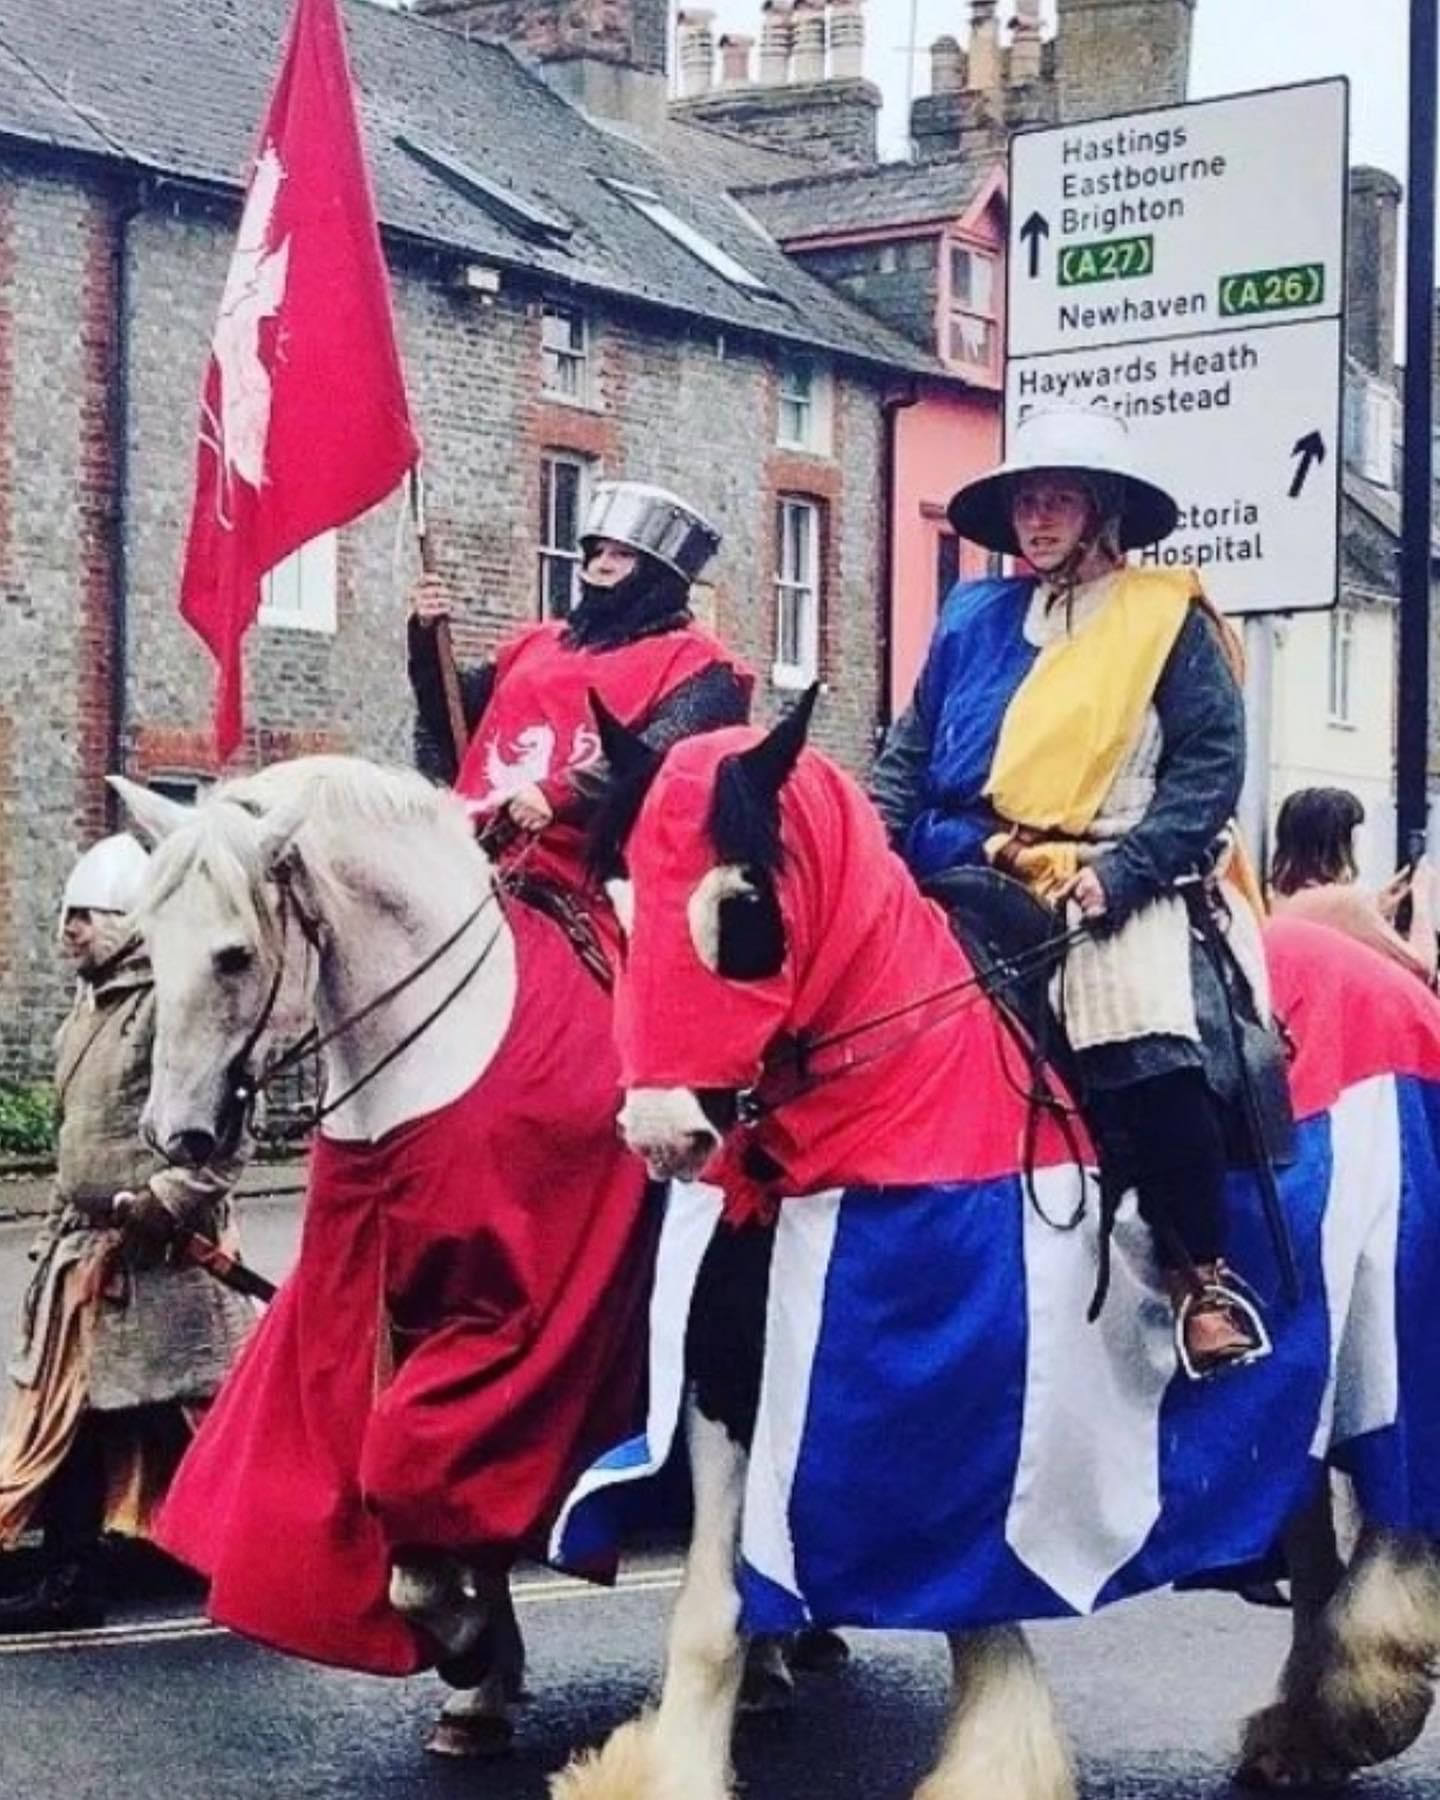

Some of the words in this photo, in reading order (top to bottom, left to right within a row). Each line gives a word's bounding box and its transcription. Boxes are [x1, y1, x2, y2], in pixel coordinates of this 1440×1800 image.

[1062, 126, 1187, 164] Hastings
[1063, 155, 1226, 199] Eastbourne
[1061, 197, 1184, 234] Brighton
[1062, 239, 1150, 282] (A27)
[1059, 292, 1206, 330] Newhaven
[1223, 268, 1319, 313] (A26)
[1019, 356, 1157, 396] Haywards
[1170, 343, 1258, 377] Heath
[1176, 499, 1258, 531] ctoria
[1140, 532, 1263, 568] Hospital
